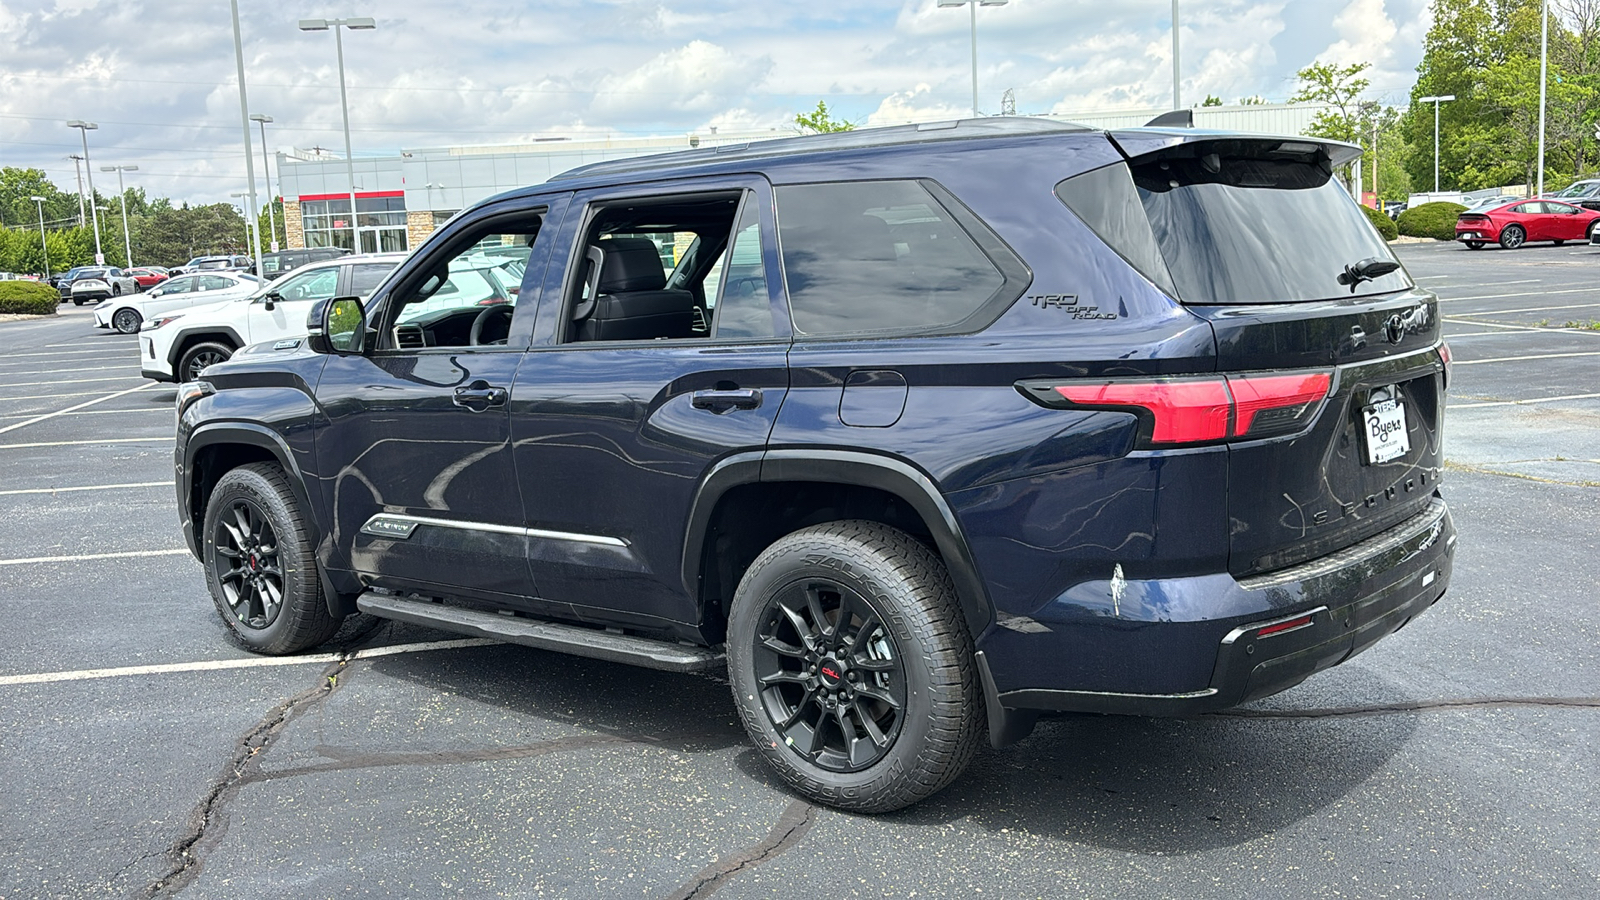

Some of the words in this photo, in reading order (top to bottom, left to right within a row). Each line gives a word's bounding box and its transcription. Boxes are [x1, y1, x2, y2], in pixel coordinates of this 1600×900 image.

[1028, 294, 1078, 309] TRD
[1367, 416, 1401, 443] Byers
[375, 521, 409, 531] PLATINUM
